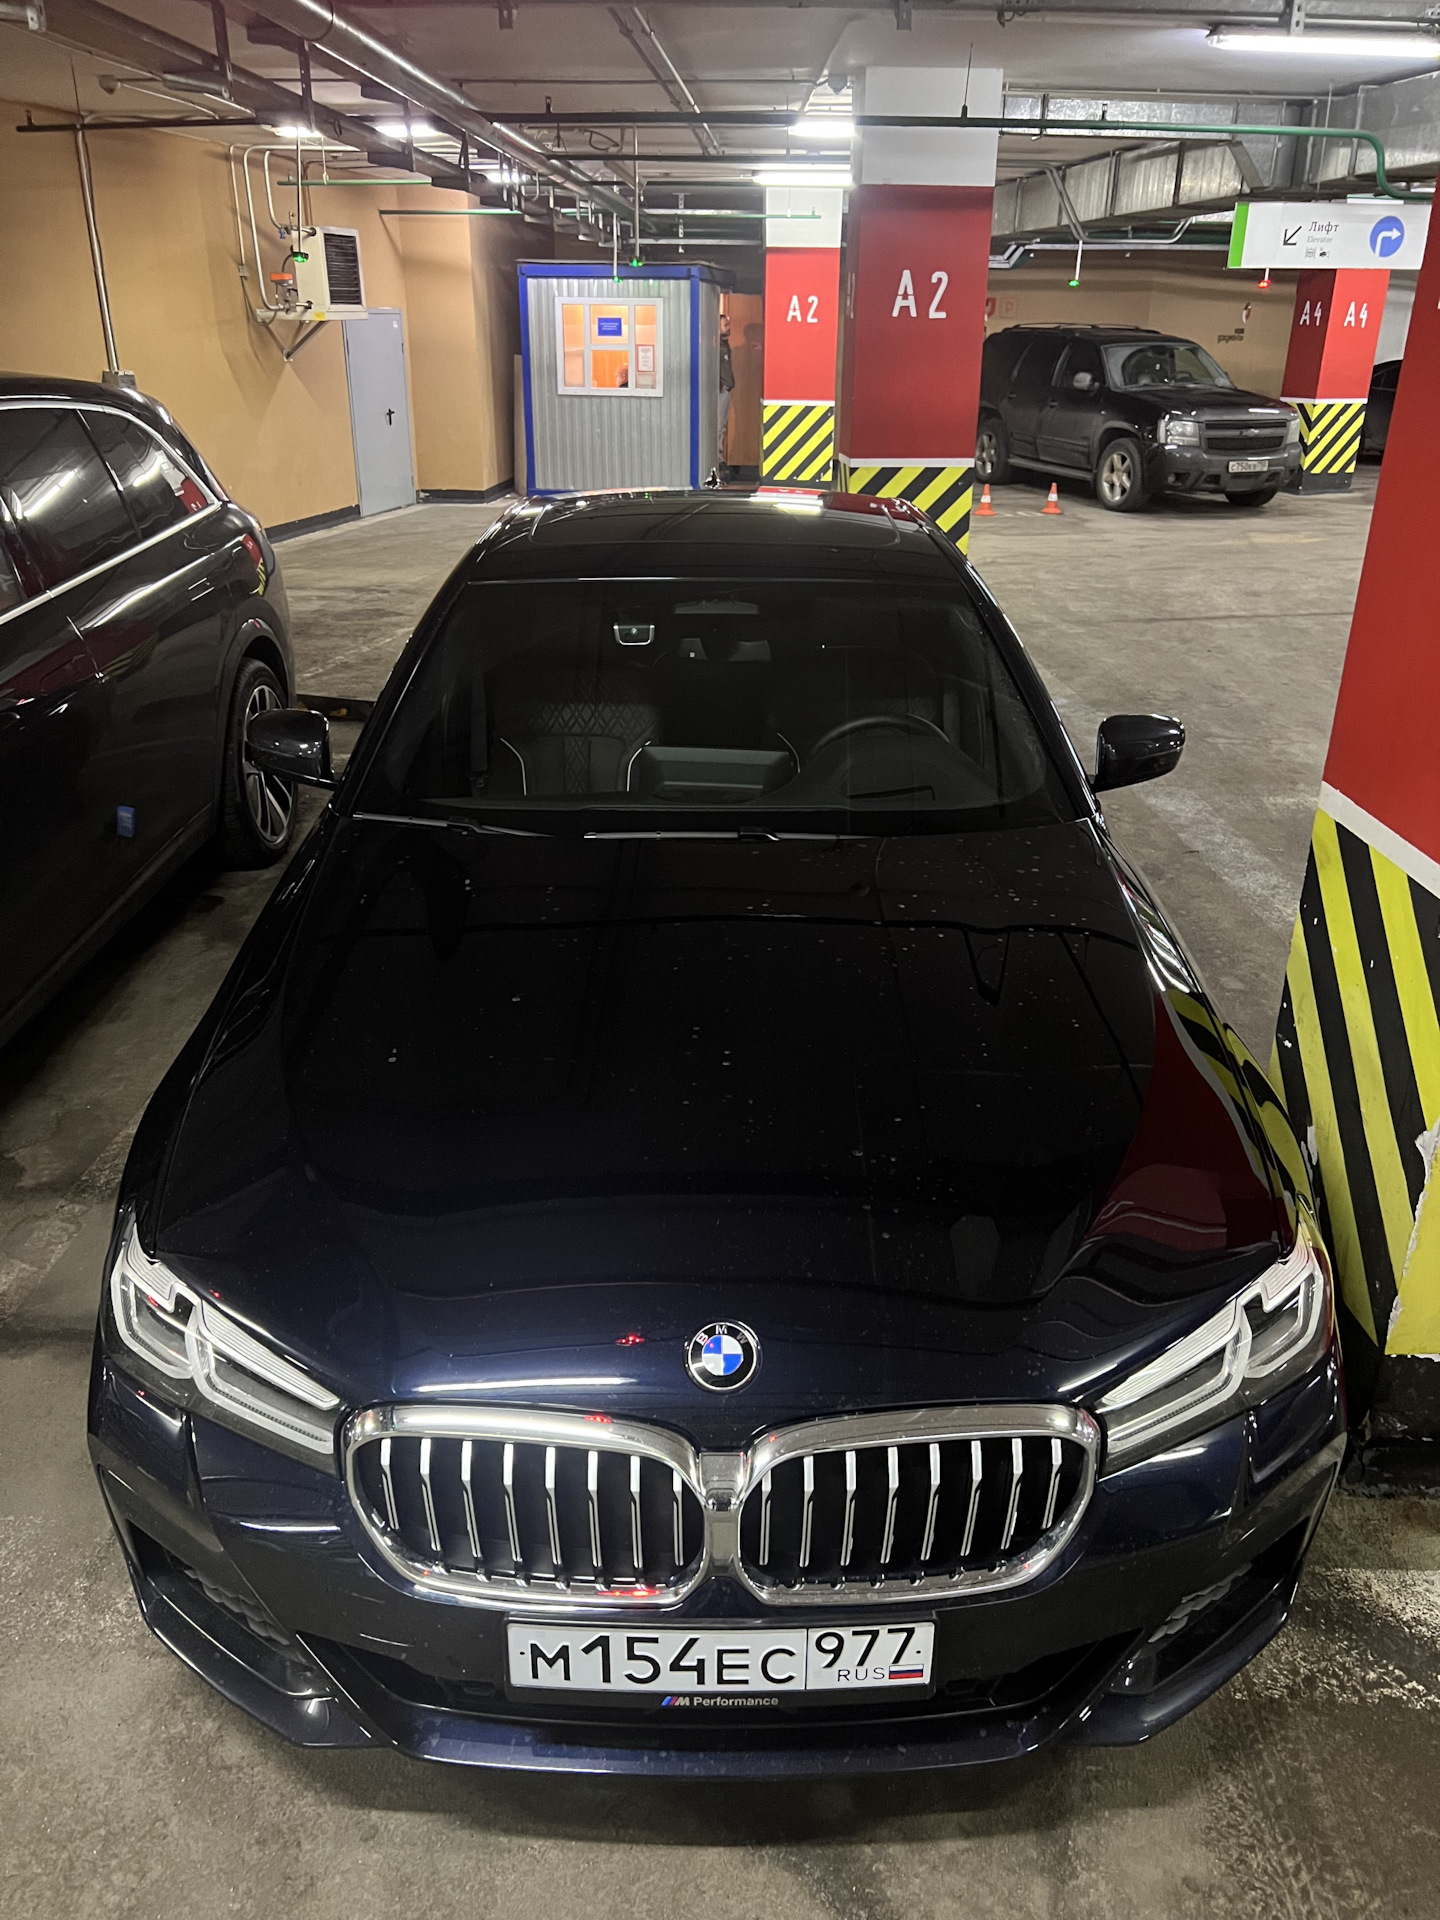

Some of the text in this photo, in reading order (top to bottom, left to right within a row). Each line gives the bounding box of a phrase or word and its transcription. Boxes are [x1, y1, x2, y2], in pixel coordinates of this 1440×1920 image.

[1308, 221, 1340, 235] Лифт
[1306, 235, 1334, 243] Elevator
[695, 1324, 749, 1346] BMW
[529, 1627, 918, 1686] М154ЕС 977
[836, 1666, 886, 1682] RUS
[693, 1697, 779, 1707] Performance
